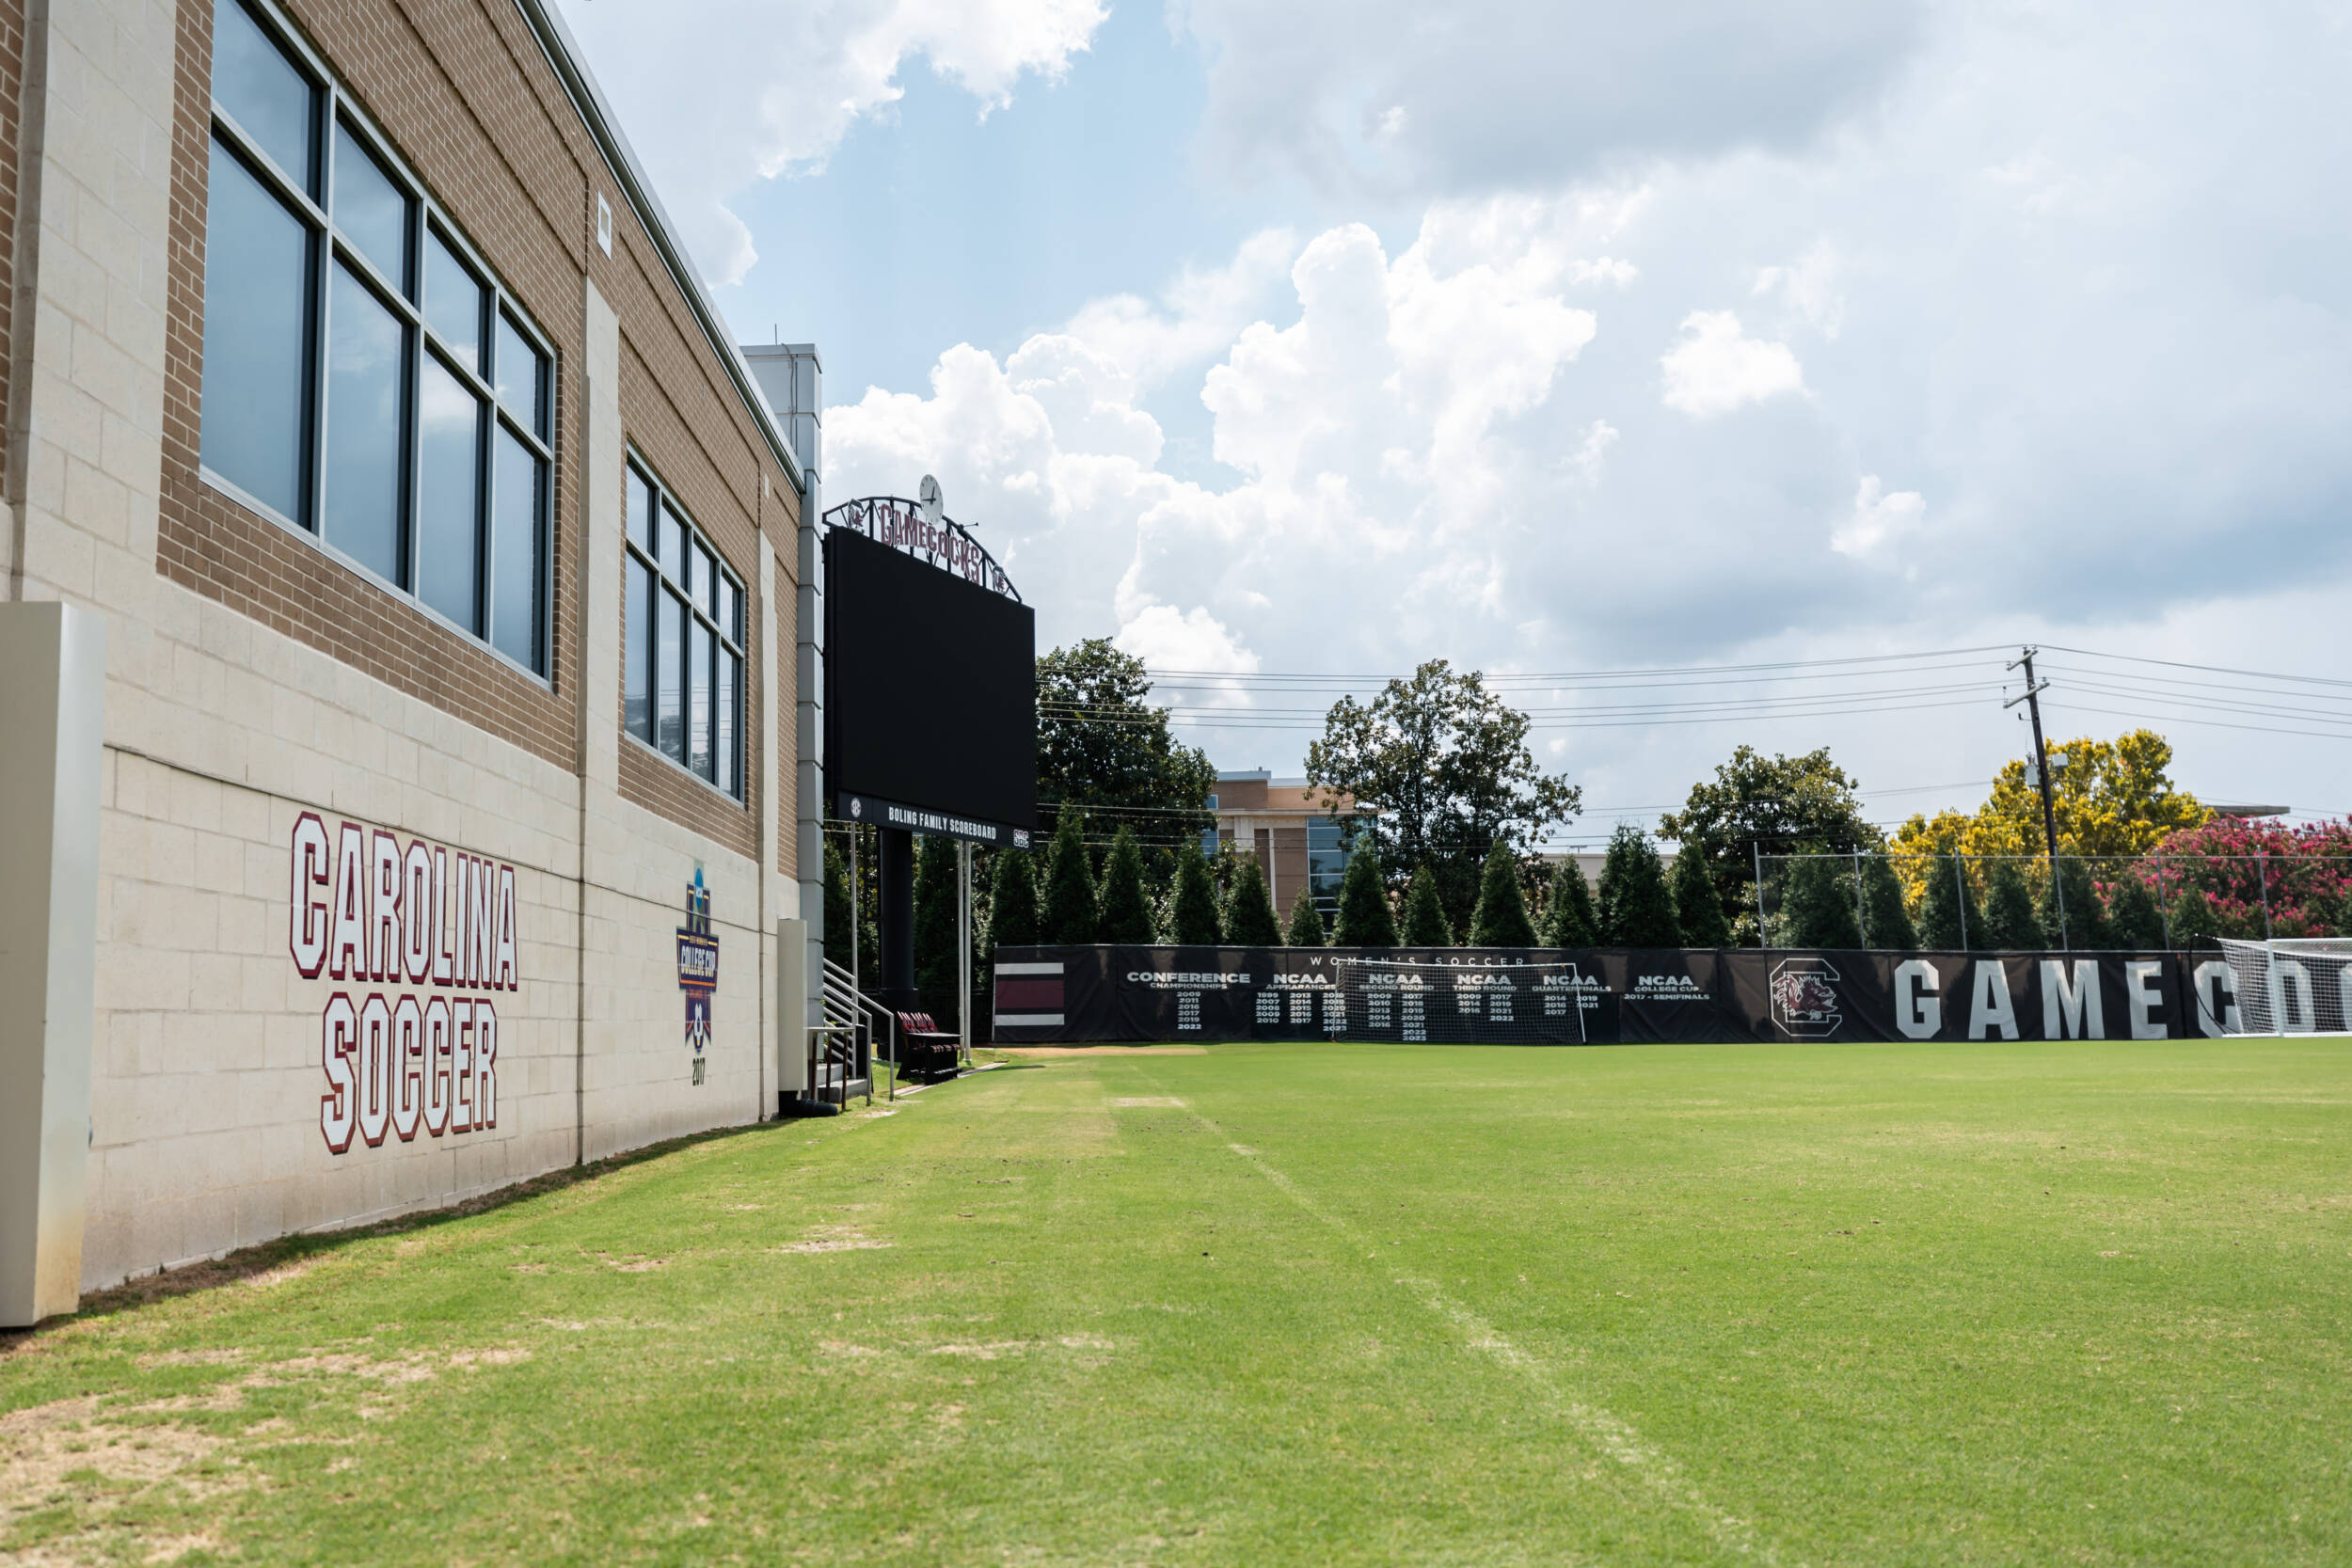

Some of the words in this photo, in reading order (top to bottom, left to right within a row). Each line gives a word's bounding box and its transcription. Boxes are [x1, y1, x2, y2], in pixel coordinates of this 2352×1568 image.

[878, 503, 981, 586] GAMECOCKS
[888, 806, 917, 825] BOLING
[920, 812, 947, 831] FAMILY
[949, 818, 996, 840] SCOREBOARD
[290, 811, 517, 991] CAROLINA
[1436, 957, 1524, 966] SOCCER
[1127, 972, 1250, 984] CONFERENCE
[1274, 974, 1328, 984] NCAA
[1369, 974, 1423, 984] NCAA
[1457, 974, 1512, 985] NCAA
[1543, 975, 1598, 986] NCAA
[1638, 975, 1693, 986] NCAA
[1894, 958, 2352, 1039] GAMECO
[320, 991, 497, 1155] SOCCER
[692, 1057, 706, 1086] 2017
